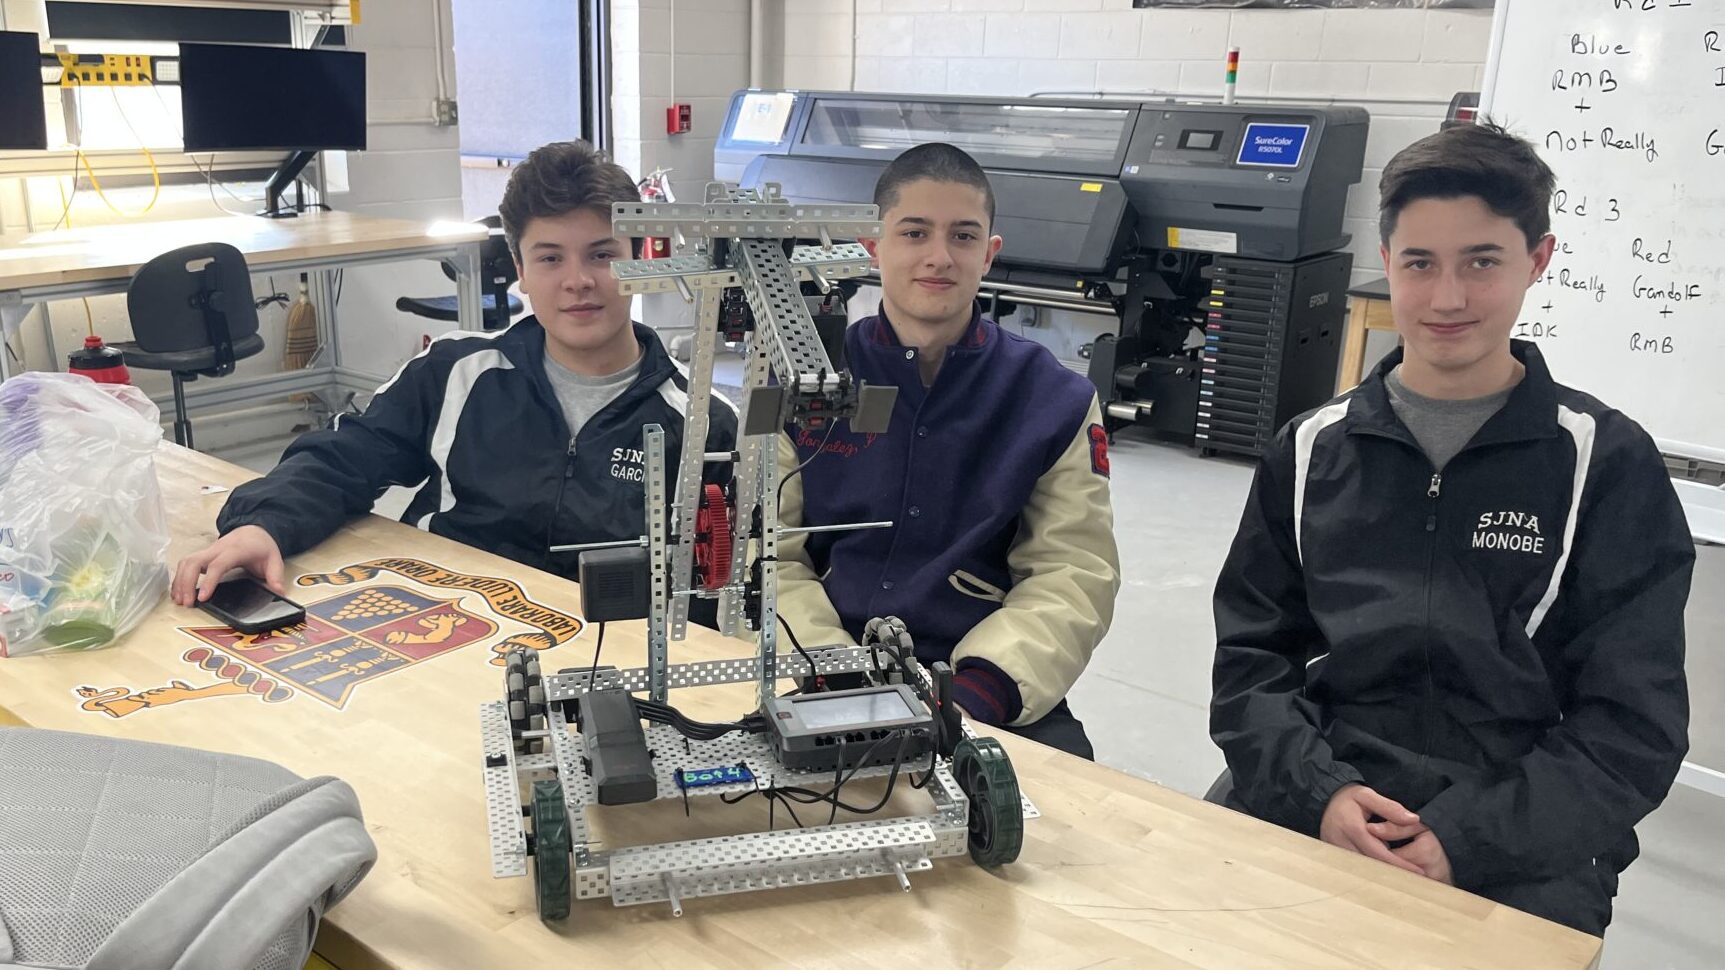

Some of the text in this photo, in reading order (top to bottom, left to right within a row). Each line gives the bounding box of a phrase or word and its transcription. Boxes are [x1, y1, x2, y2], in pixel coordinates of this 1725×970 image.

[1571, 33, 1631, 54] Blue
[1255, 136, 1294, 146] SureColor
[1600, 127, 1659, 162] Really
[1604, 198, 1621, 221] 3
[1632, 237, 1672, 264] Red
[1559, 268, 1607, 302] Really
[610, 447, 645, 465] SJN
[1478, 511, 1541, 534] SJNA
[1472, 531, 1545, 554] MONOBE
[429, 573, 515, 598] LUDERE
[499, 594, 577, 636] LABORARE
[727, 767, 741, 778] 4
